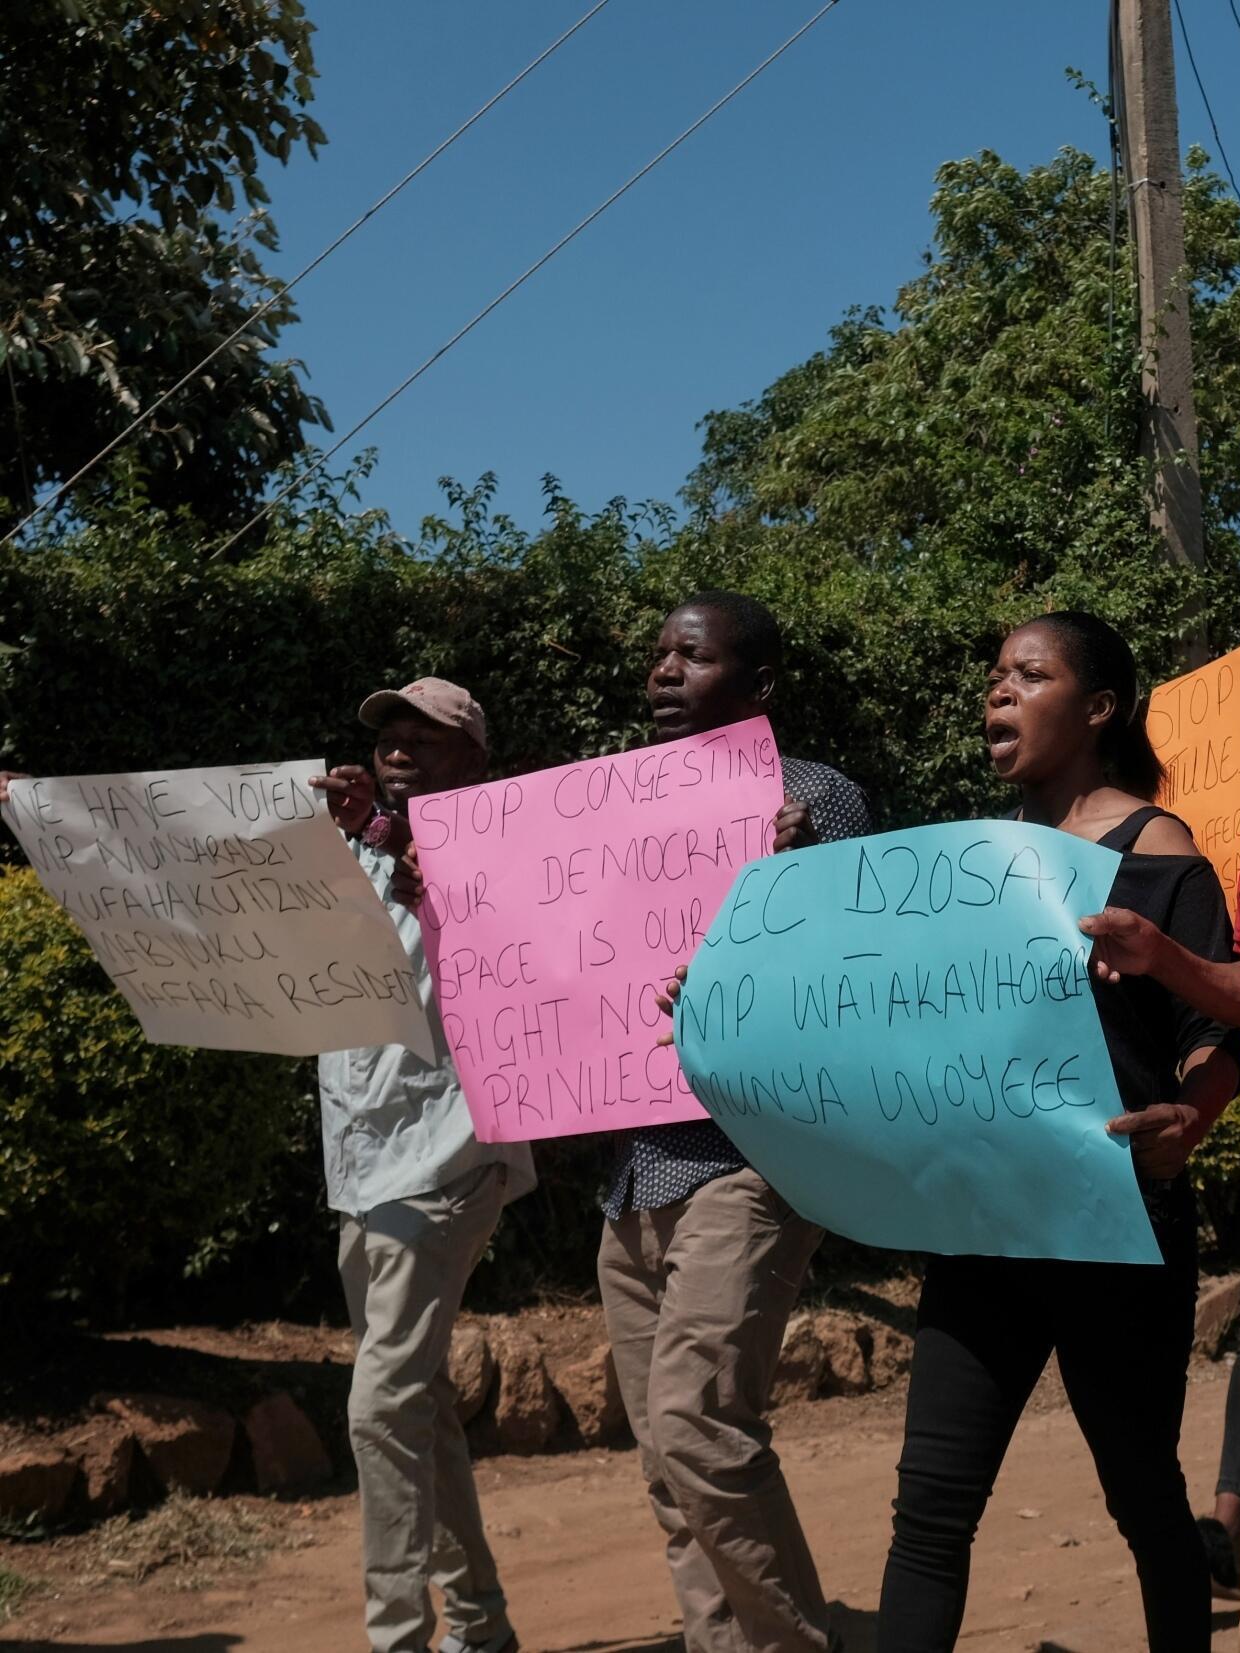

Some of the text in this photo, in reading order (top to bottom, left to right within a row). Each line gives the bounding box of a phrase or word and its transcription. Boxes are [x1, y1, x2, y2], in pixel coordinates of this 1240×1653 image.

[1149, 664, 1234, 751] STOP
[5, 771, 315, 832] WE HAVE VOTED
[416, 733, 779, 851] STOP CONGESTING
[26, 834, 74, 874] MP
[420, 871, 496, 932] OUR
[436, 897, 707, 1001] SPACE IS OUR
[112, 968, 275, 1020] TAFARA
[442, 975, 677, 1070] RIGHT NO
[680, 973, 755, 1047] MP
[691, 1062, 849, 1125] MUNYA
